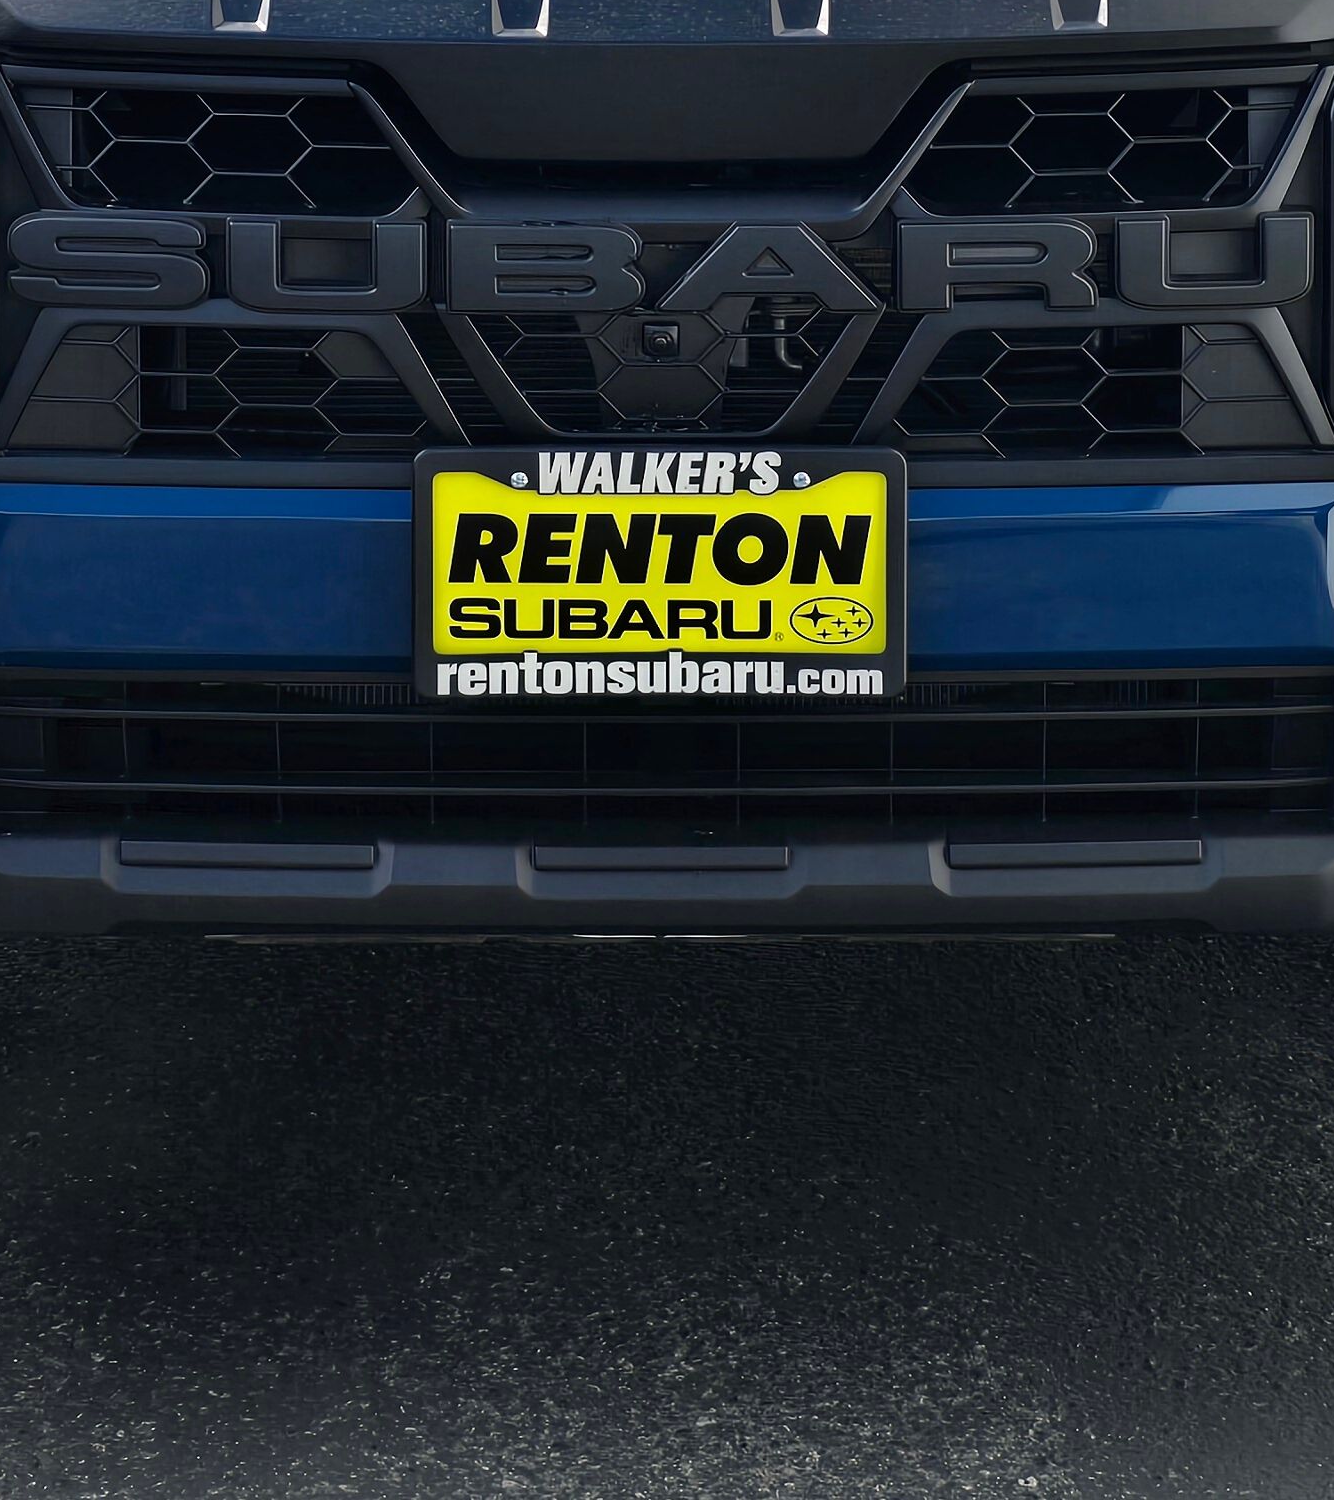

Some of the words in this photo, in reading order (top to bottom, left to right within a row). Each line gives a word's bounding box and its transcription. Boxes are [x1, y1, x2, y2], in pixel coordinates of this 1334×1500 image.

[7, 211, 1315, 316] SUBARU
[538, 450, 782, 496] WALKER'S
[448, 512, 873, 586] RENTON
[448, 597, 772, 640] SUBARU
[436, 651, 884, 696] rentonsubaru.com
